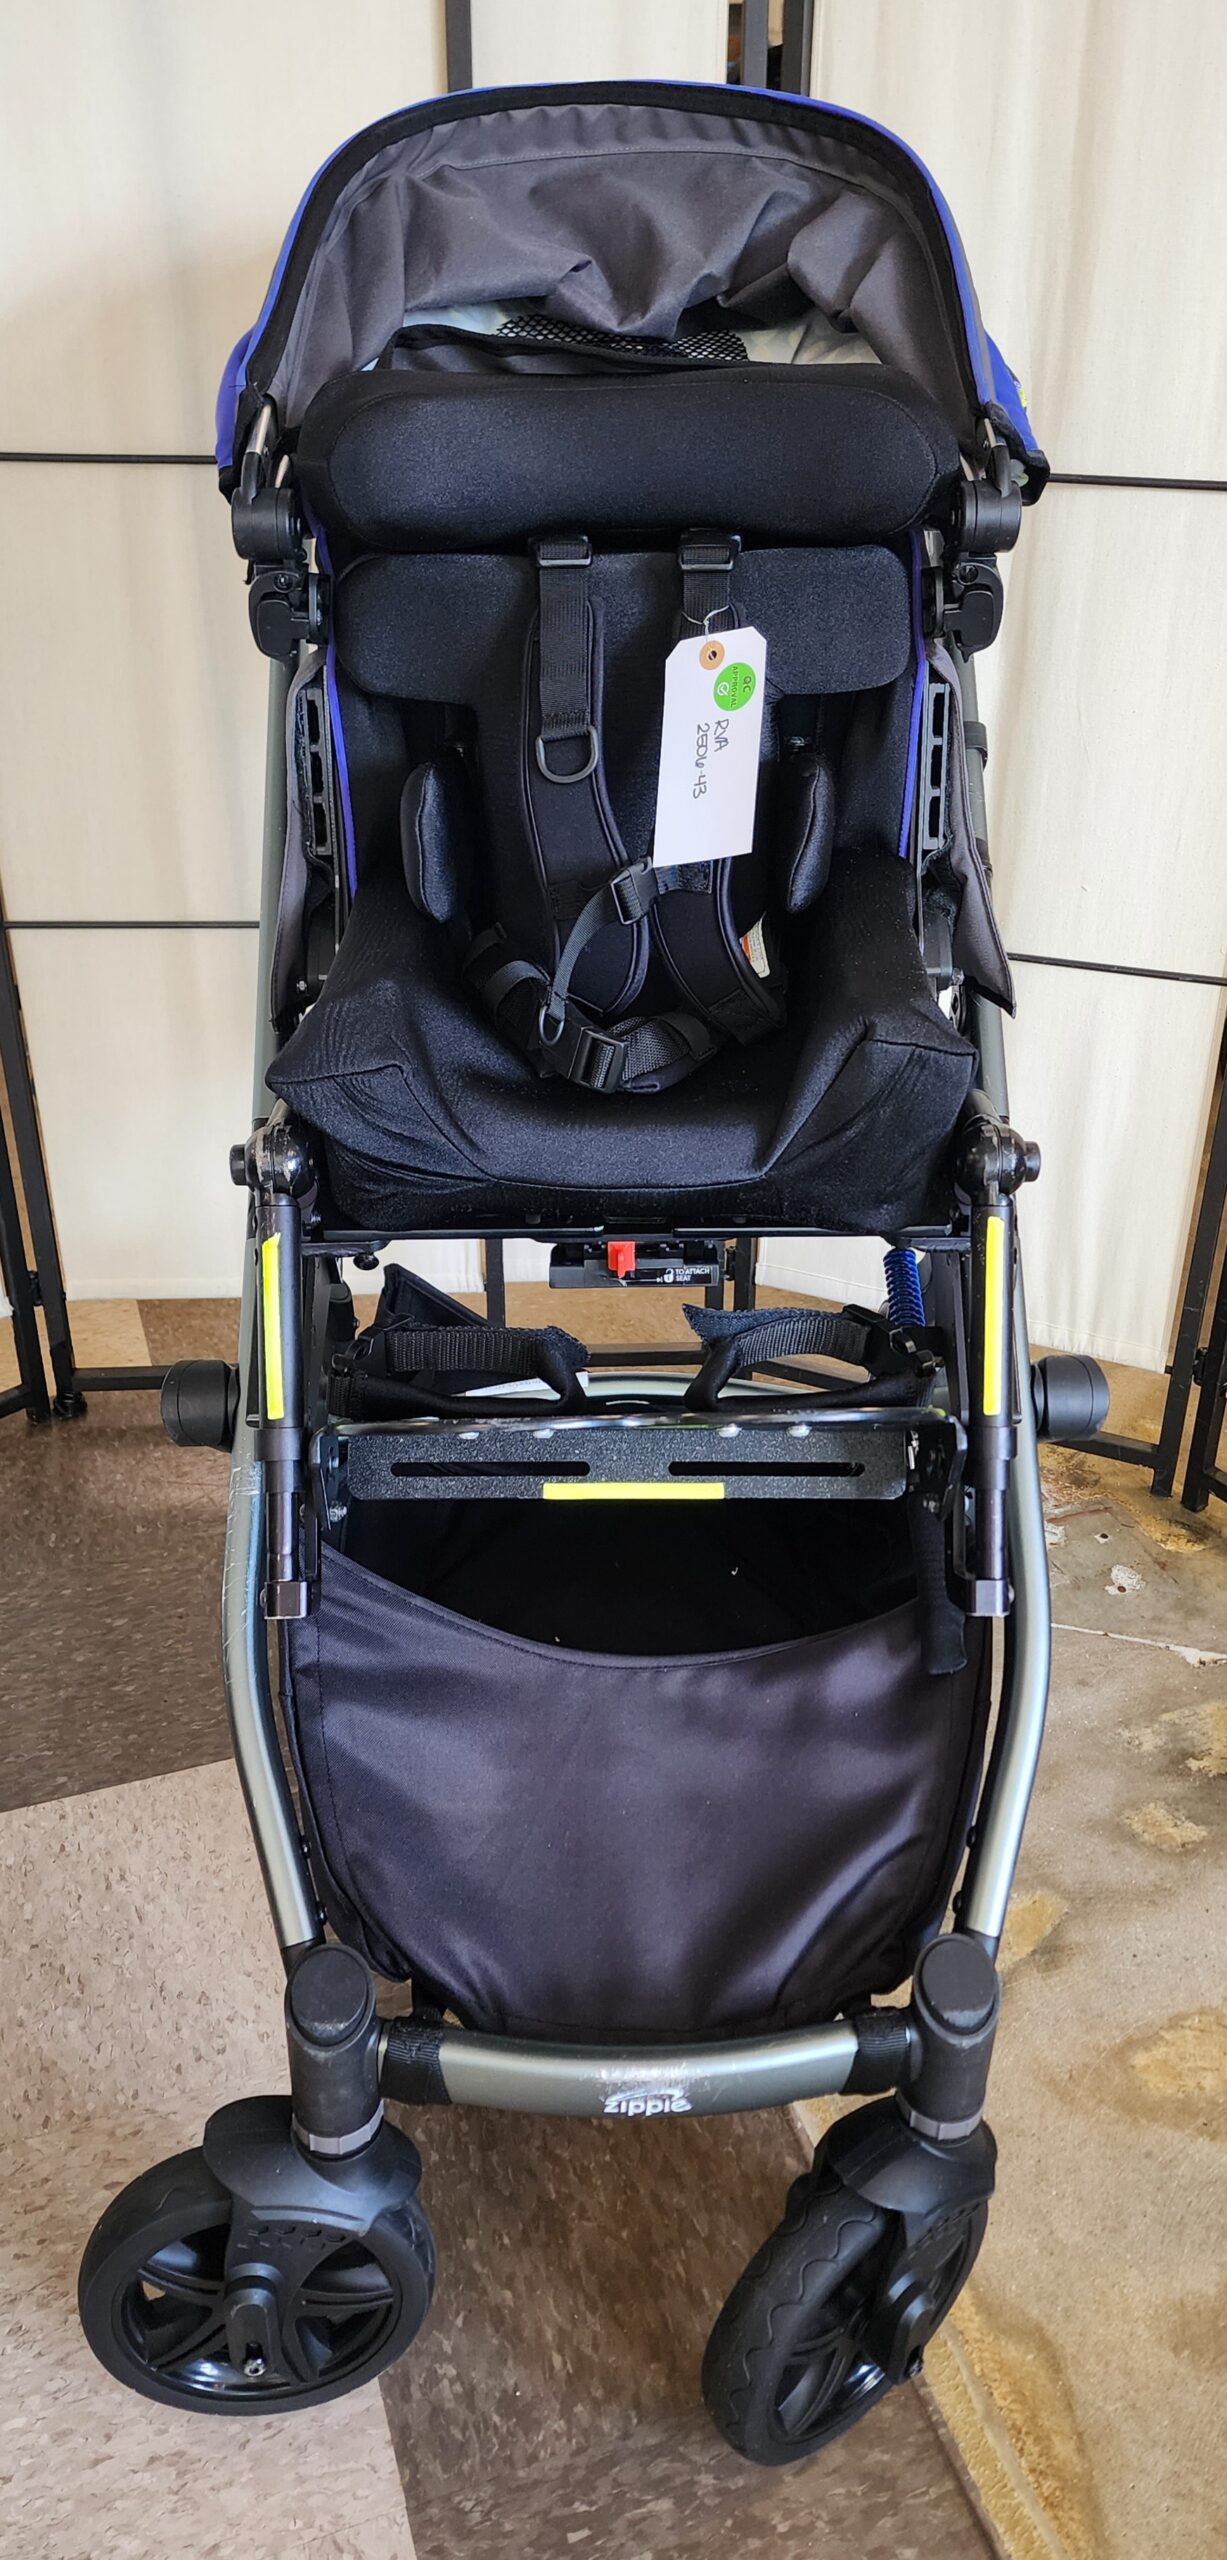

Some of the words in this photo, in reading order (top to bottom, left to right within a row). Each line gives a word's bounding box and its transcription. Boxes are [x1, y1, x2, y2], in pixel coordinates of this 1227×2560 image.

[730, 666, 738, 707] APPROVAL
[742, 675, 752, 693] QC
[714, 718, 730, 752] RVA
